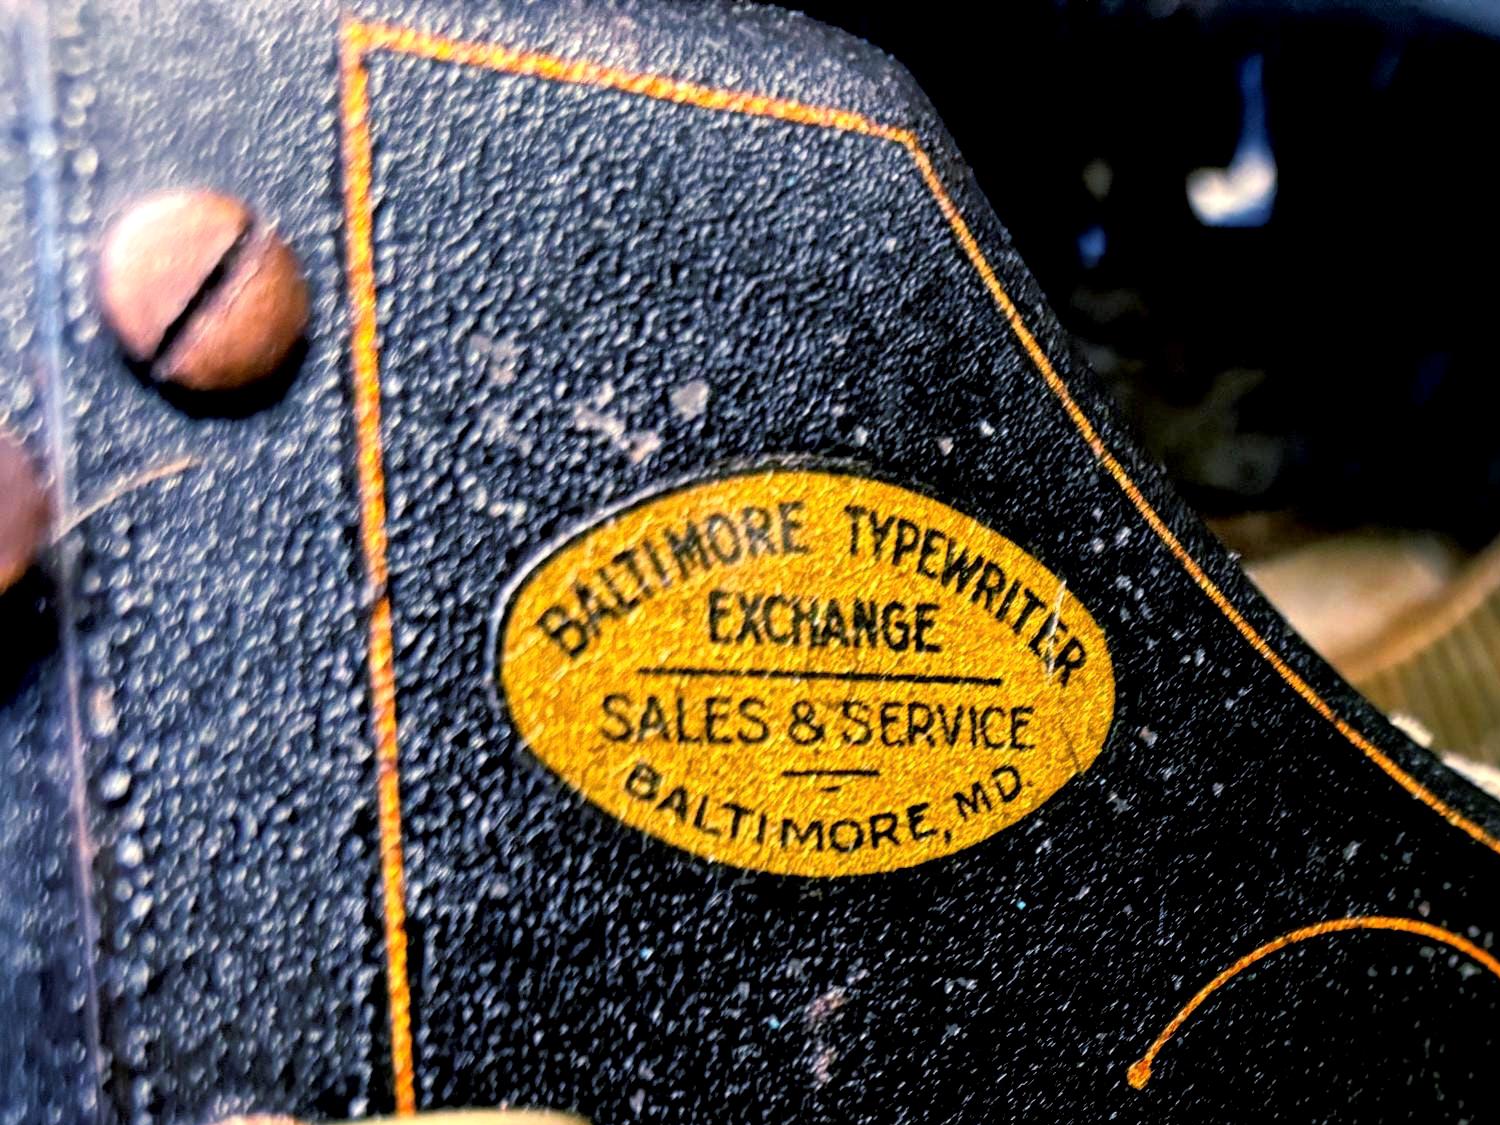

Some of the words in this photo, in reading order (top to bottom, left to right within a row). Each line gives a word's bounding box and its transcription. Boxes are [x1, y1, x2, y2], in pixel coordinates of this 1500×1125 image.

[535, 500, 808, 660] BALTIMORE
[844, 504, 1087, 688] TYPEWRITER
[708, 590, 943, 654] EXCHANGE
[600, 693, 770, 746] SALES
[788, 696, 828, 745] &
[841, 700, 1036, 752] SERVICE
